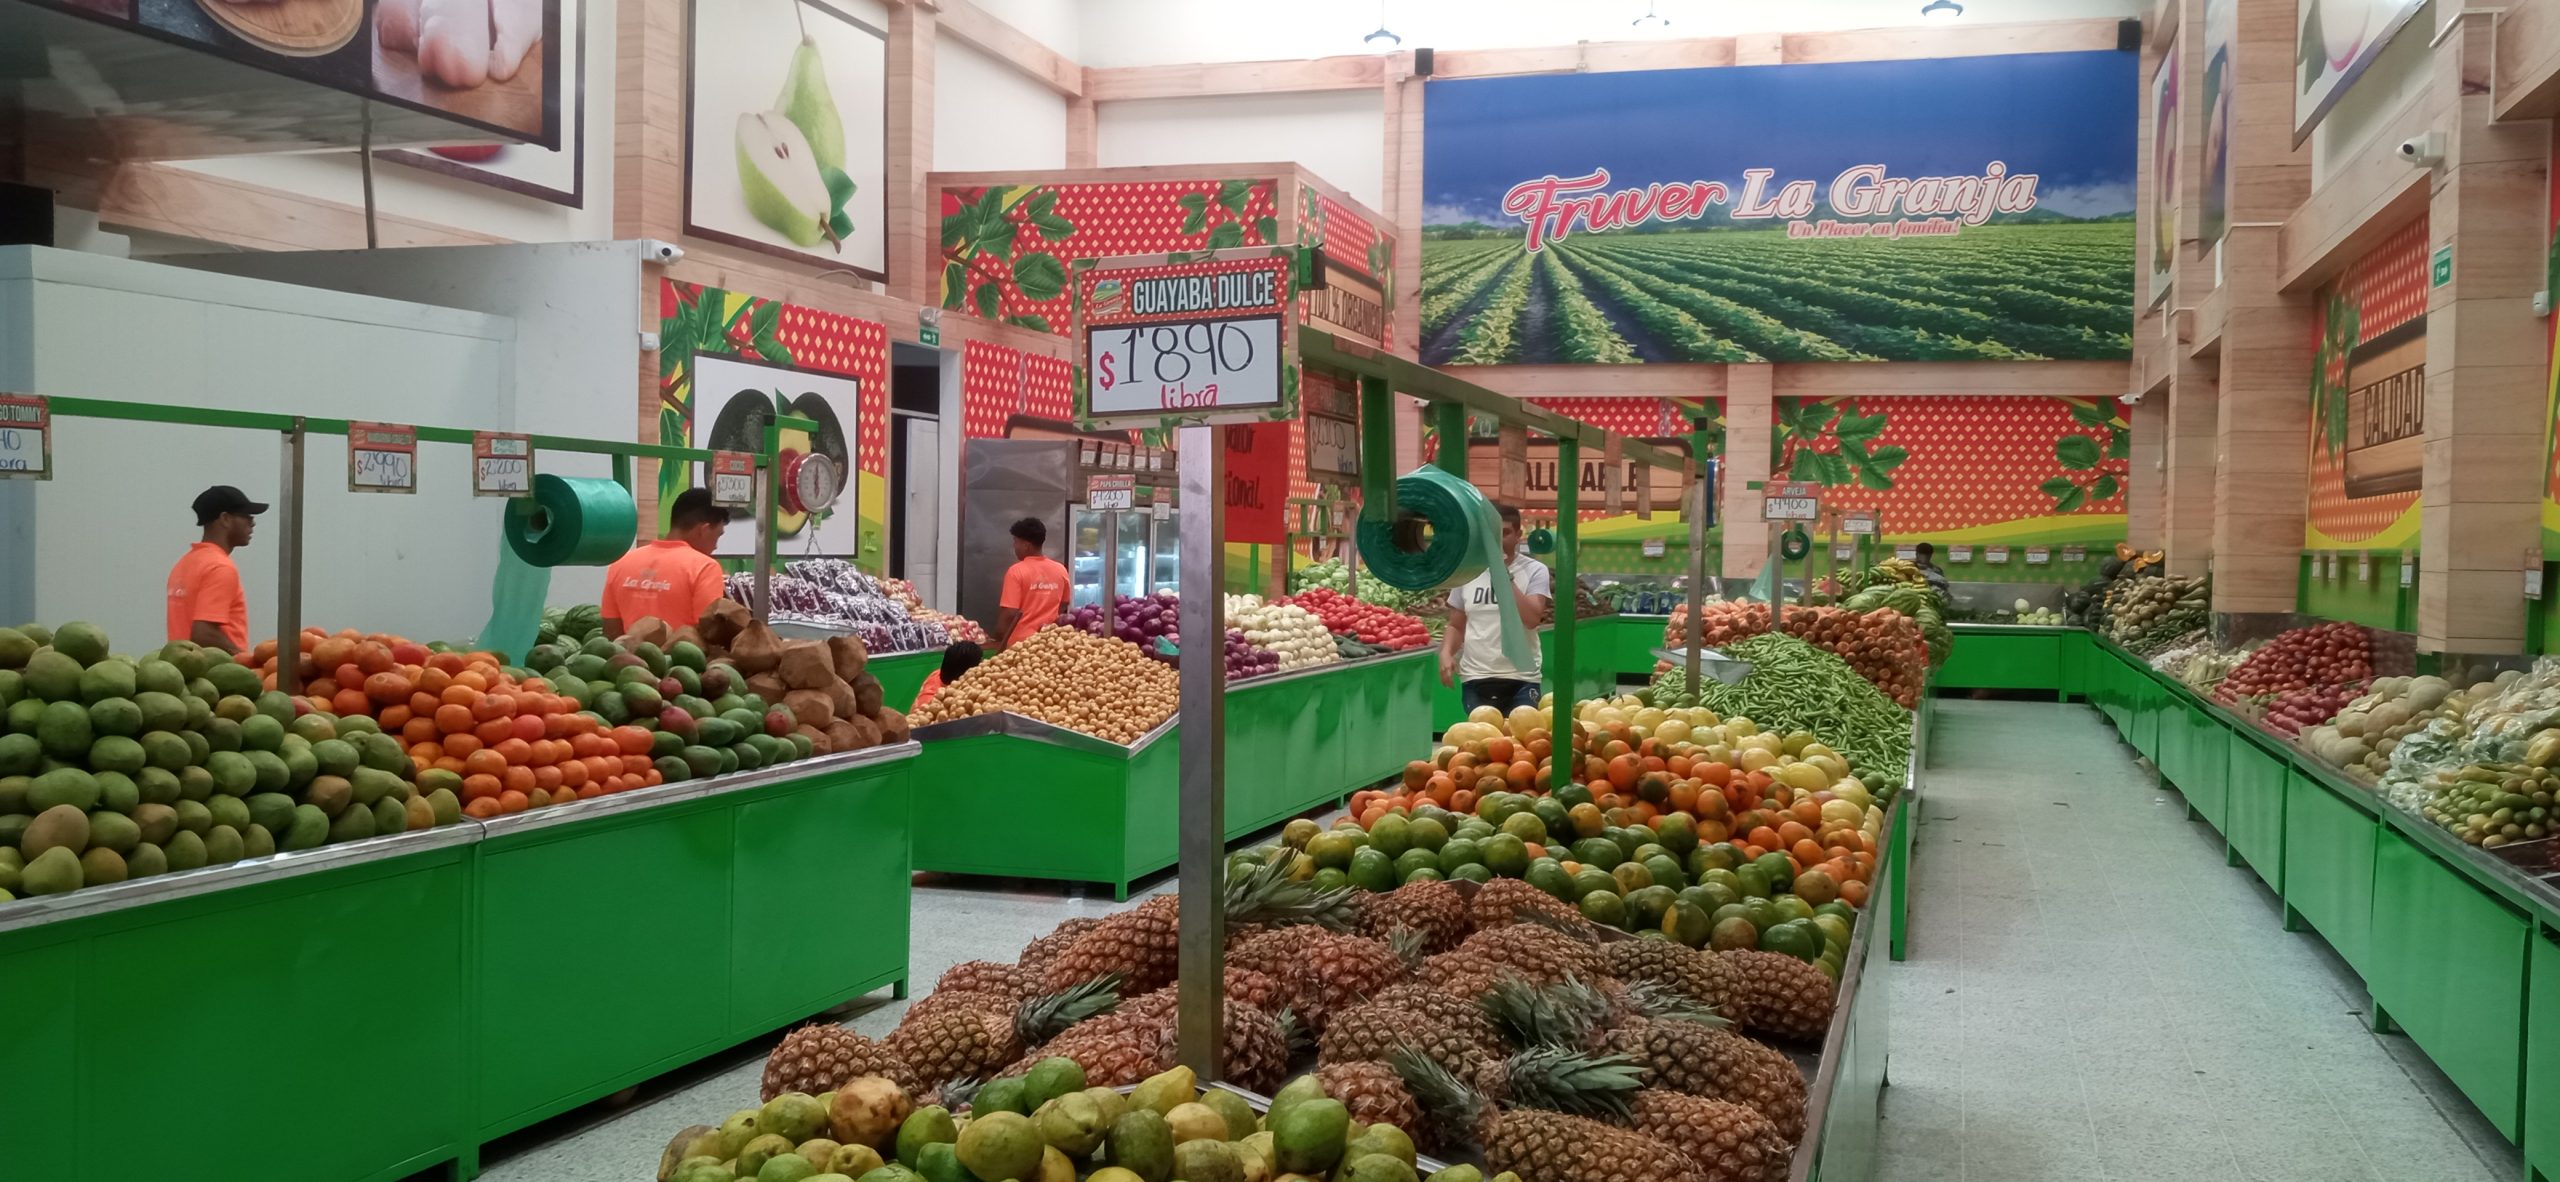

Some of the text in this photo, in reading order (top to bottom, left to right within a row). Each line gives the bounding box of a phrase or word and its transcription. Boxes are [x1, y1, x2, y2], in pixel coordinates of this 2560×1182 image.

[1502, 160, 2038, 253] Fruver La Granja
[1789, 217, 1961, 240] Un Placer en familia!
[1133, 271, 1275, 315] GUAYABA DULCE
[1160, 381, 1219, 409] libra
[2363, 366, 2425, 448] CALIDAD
[10, 406, 41, 423] TOMMY
[622, 576, 638, 588] La
